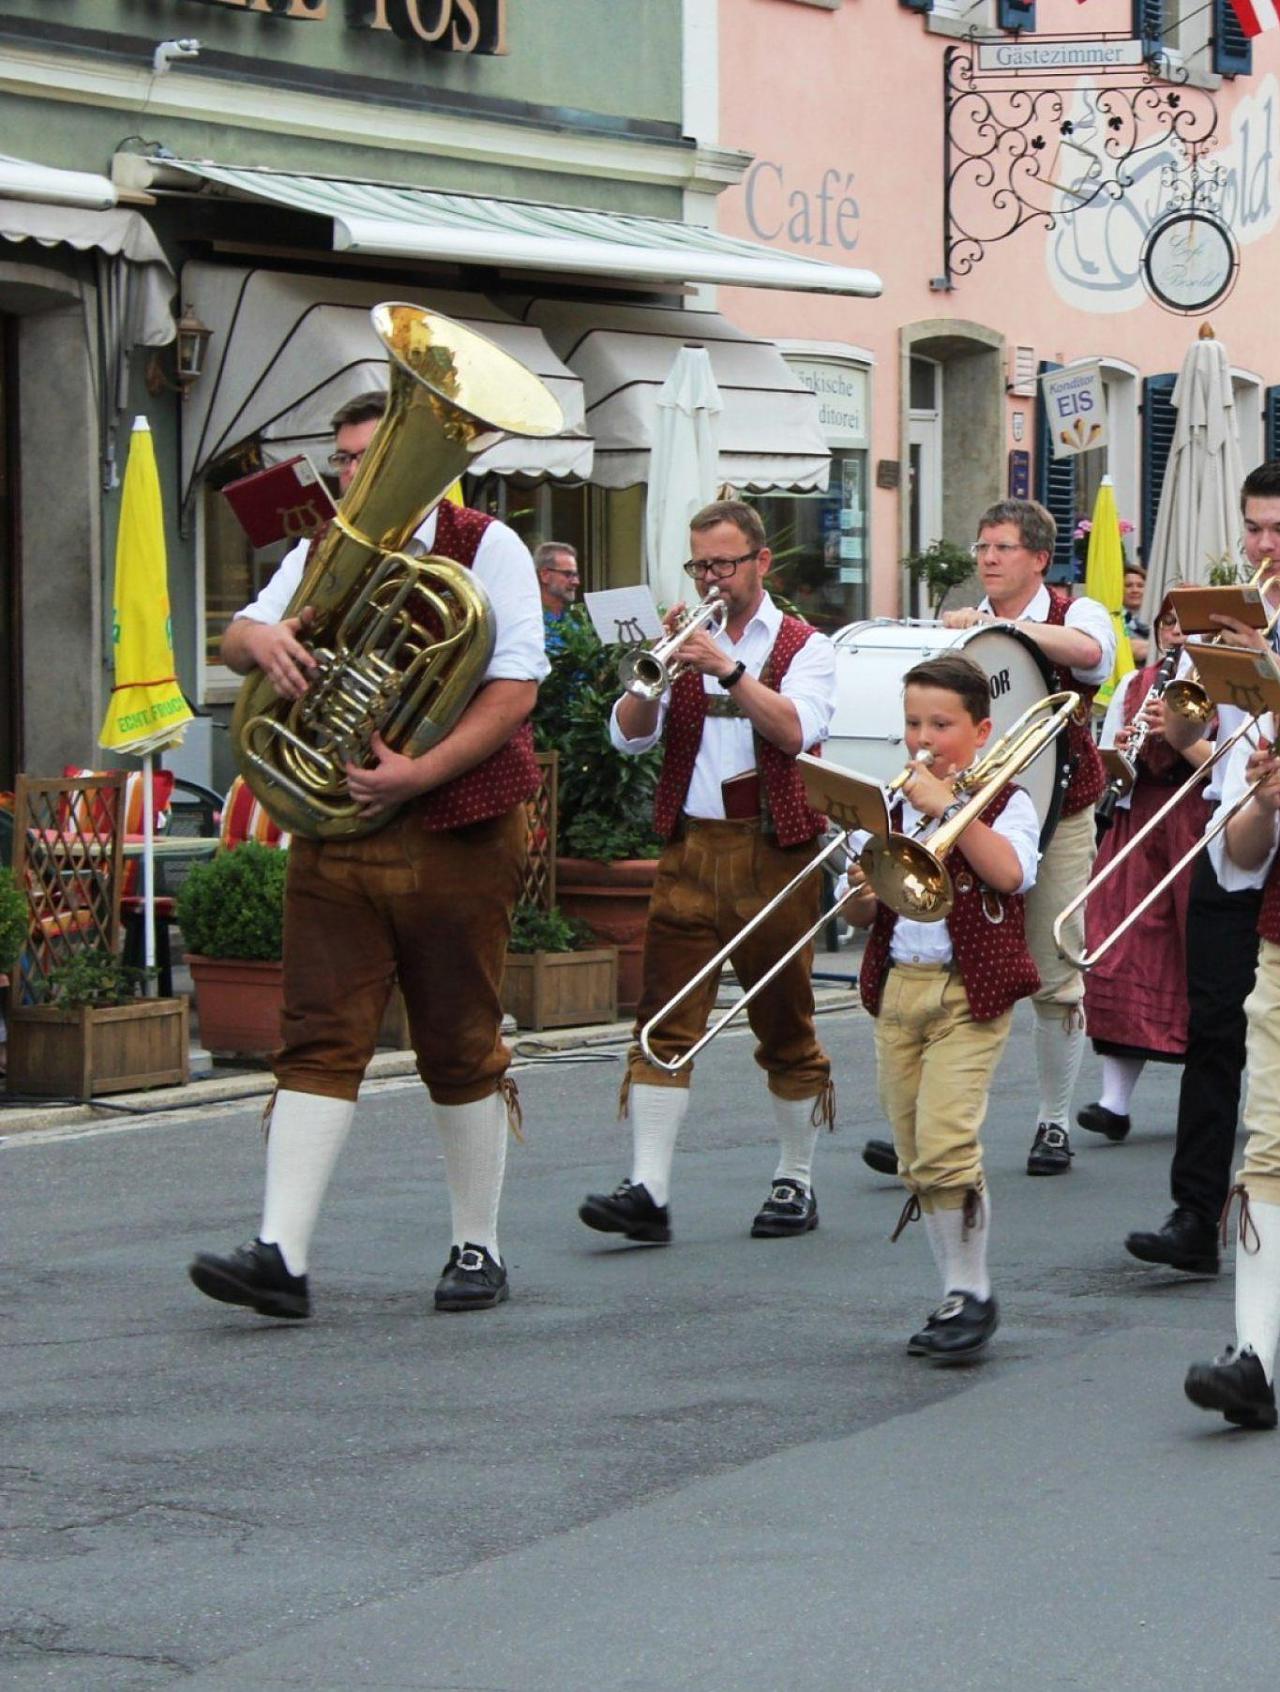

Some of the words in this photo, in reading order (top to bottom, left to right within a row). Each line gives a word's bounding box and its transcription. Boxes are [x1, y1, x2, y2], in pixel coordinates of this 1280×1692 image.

[996, 45, 1123, 65] Gästezimmer
[745, 161, 860, 250] Café
[1057, 390, 1094, 417] EIS
